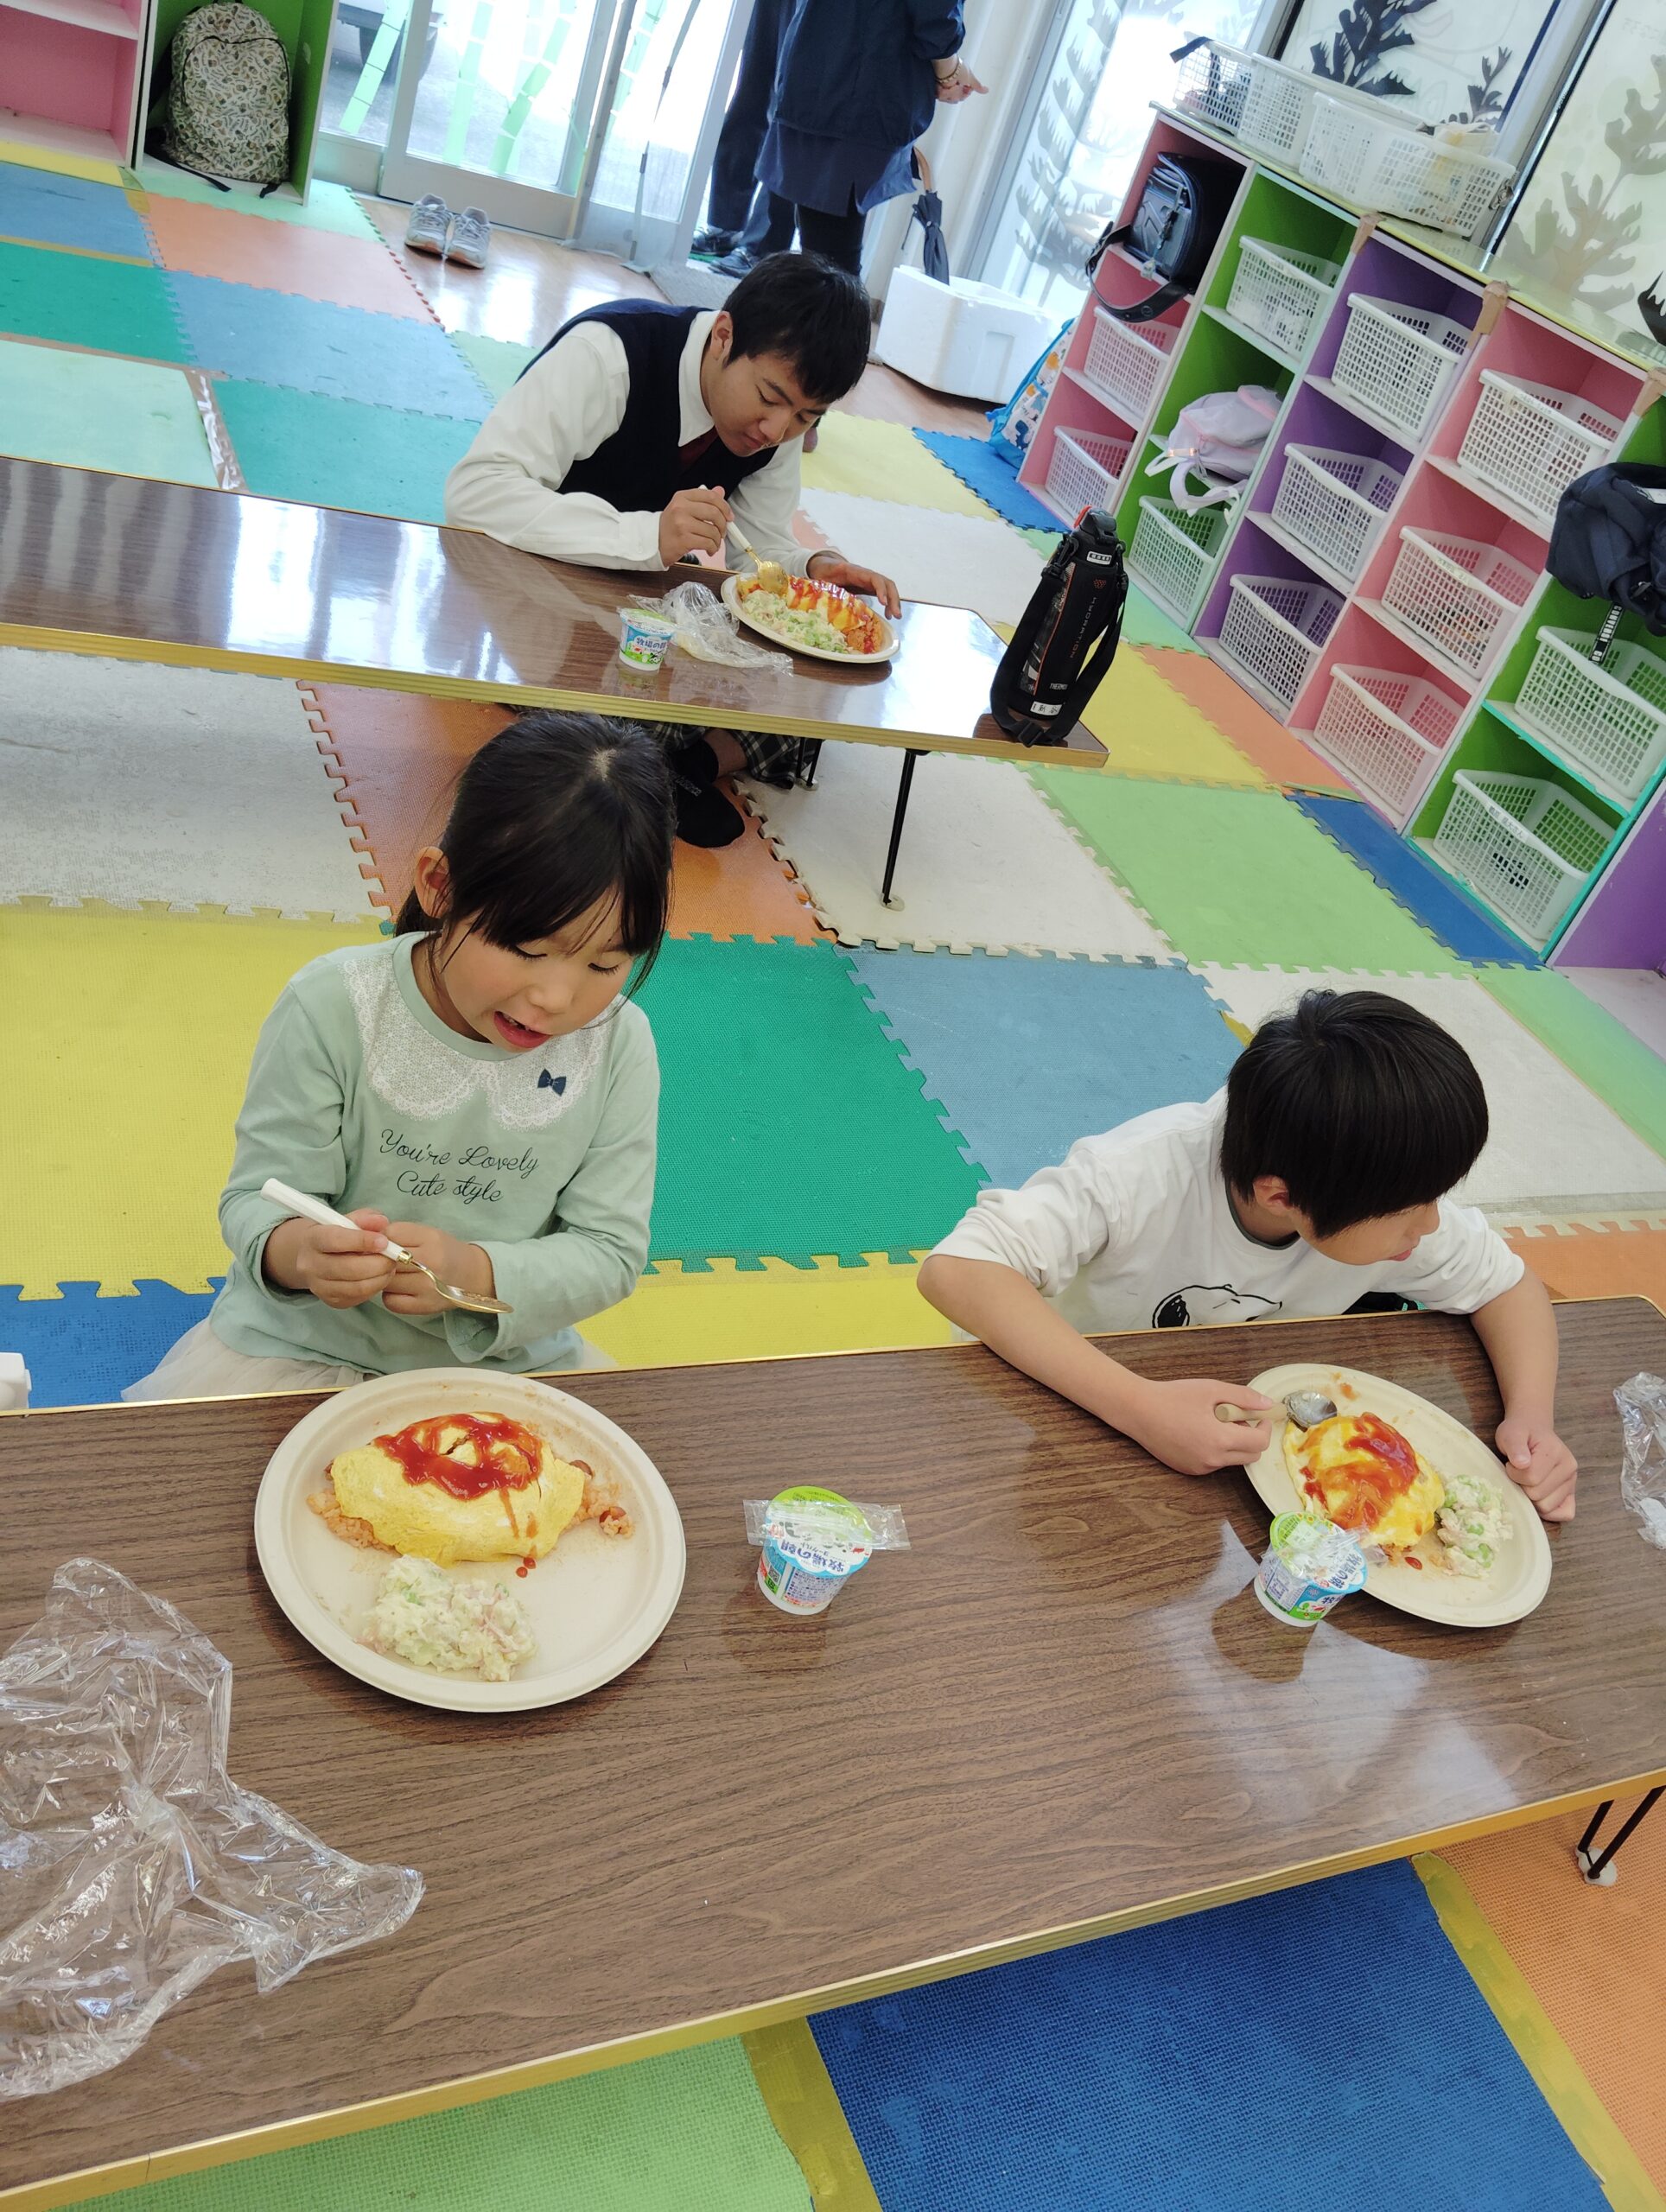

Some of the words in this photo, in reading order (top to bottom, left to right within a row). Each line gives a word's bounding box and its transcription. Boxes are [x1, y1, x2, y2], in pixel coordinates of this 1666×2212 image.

[379, 1128, 452, 1165] You're
[458, 1146, 540, 1179] Lovely
[397, 1170, 448, 1197] Cute
[453, 1175, 504, 1205] style
[780, 1540, 844, 1573] 牧場の朝
